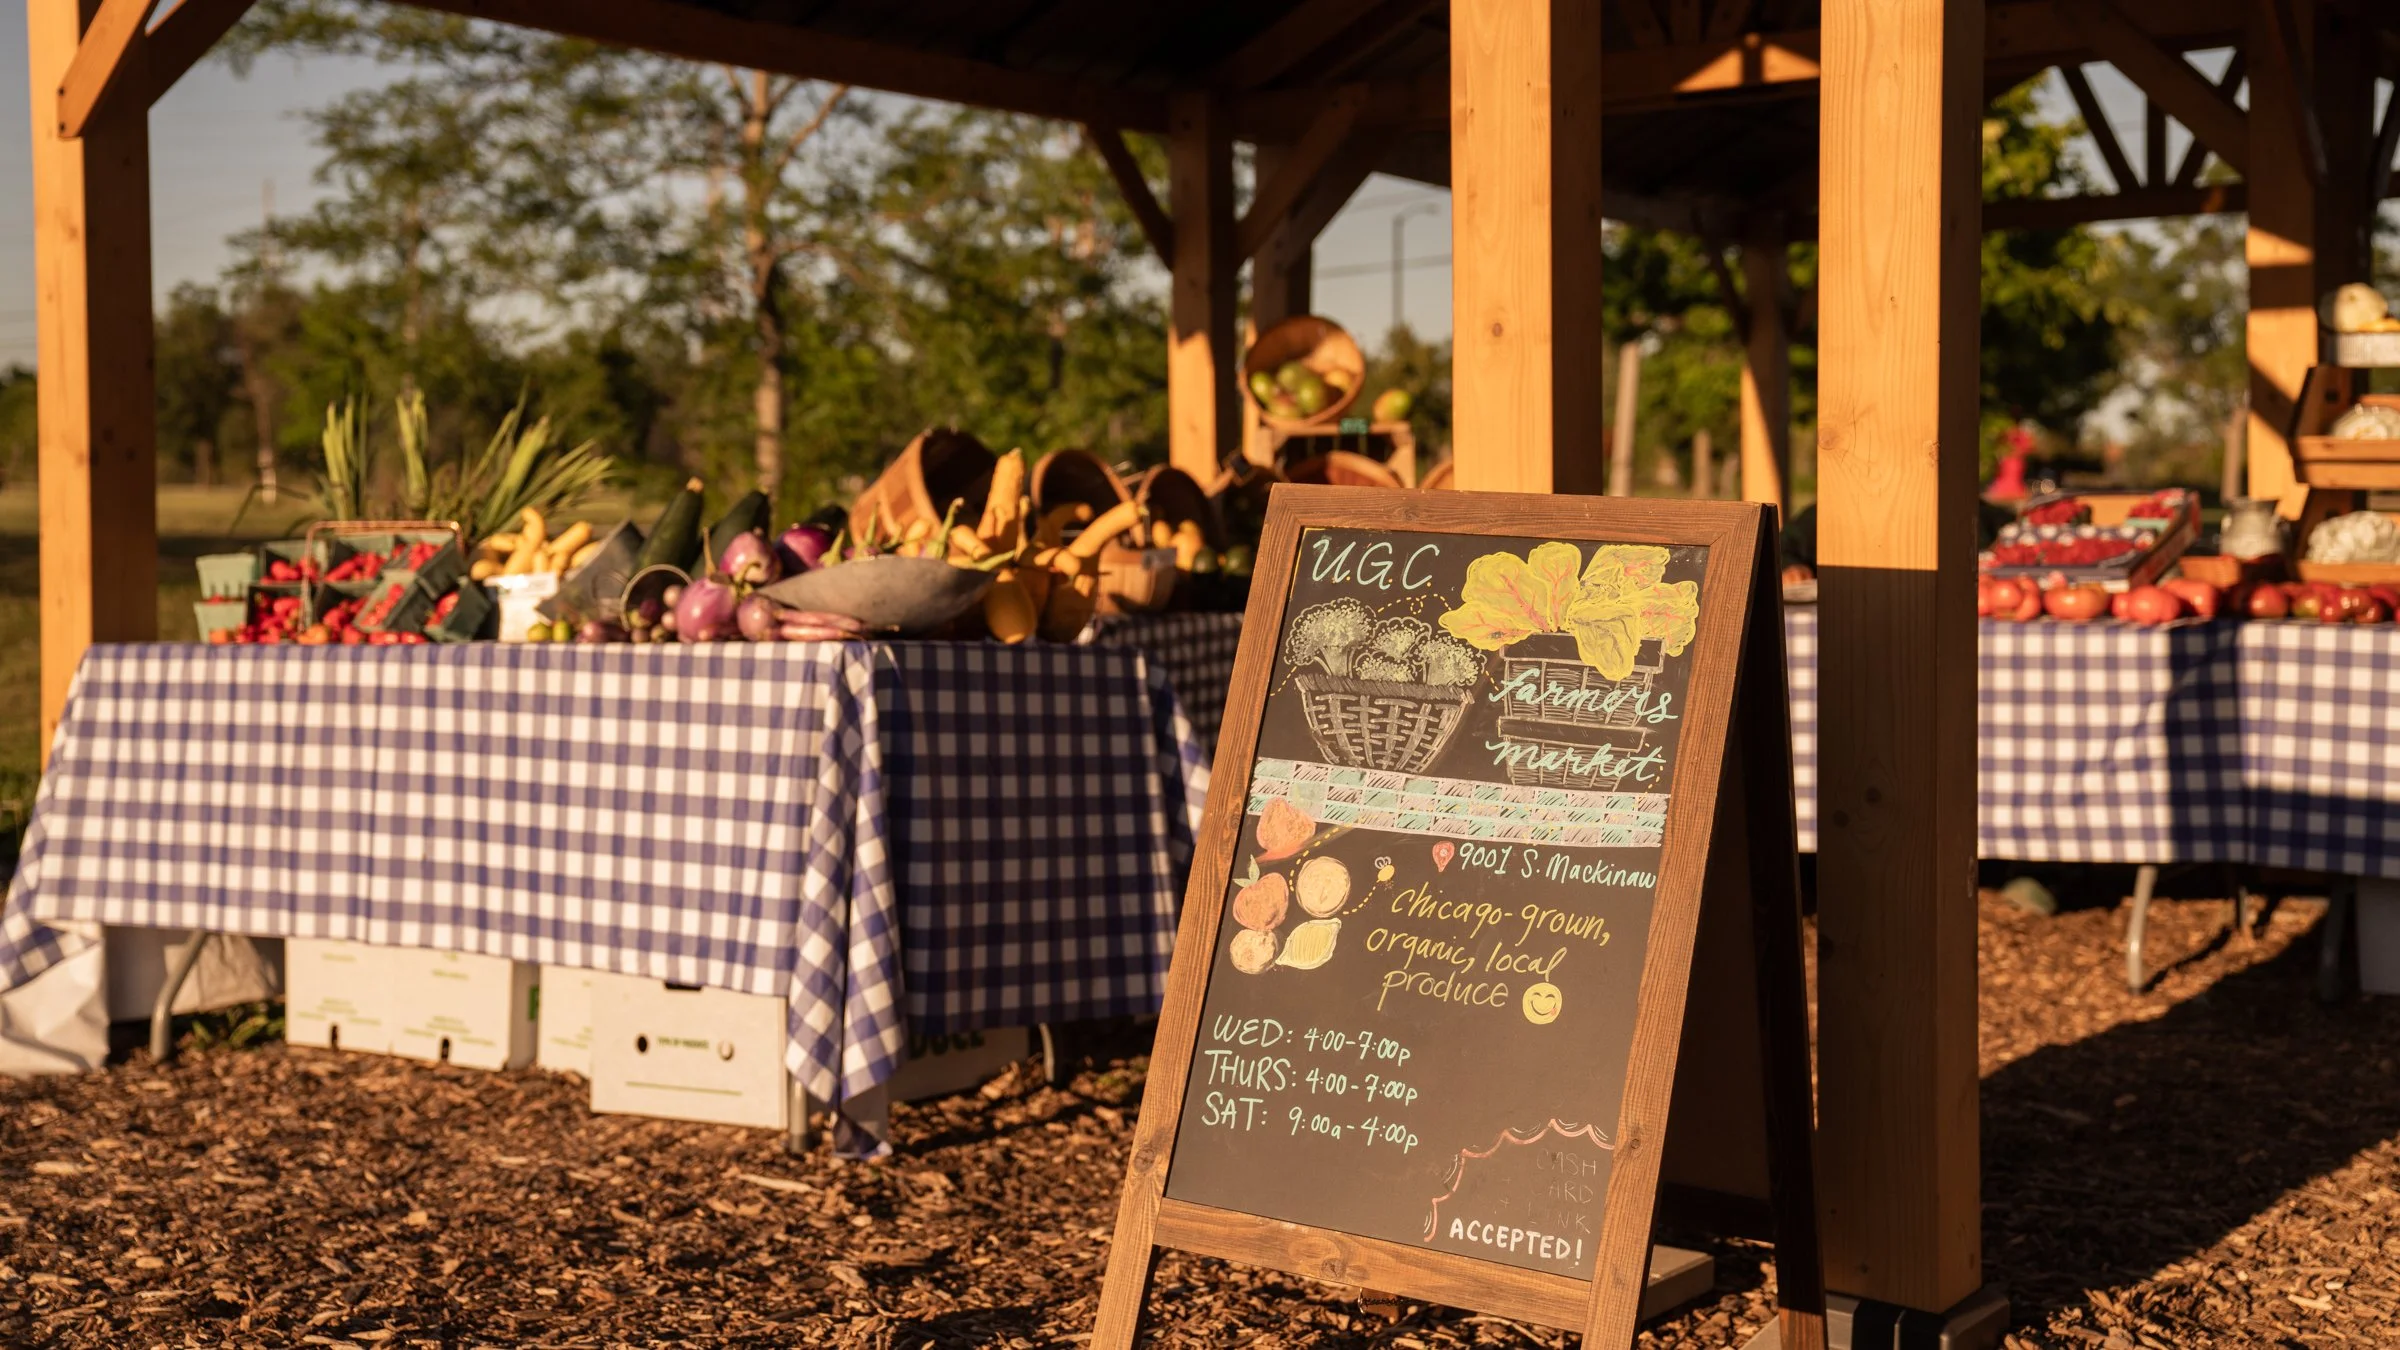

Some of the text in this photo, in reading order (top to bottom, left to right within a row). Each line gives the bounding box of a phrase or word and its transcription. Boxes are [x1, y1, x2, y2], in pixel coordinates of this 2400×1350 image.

[1459, 842, 1657, 889] 9001 S. Mackinaw
[1485, 941, 1568, 982] local
[1377, 969, 1509, 1012] produce
[1213, 1014, 1294, 1048] WED:
[1204, 1049, 1297, 1092] THURS:
[1201, 1091, 1268, 1132] SAT:
[1448, 1217, 1583, 1267] ACCEPTED!
